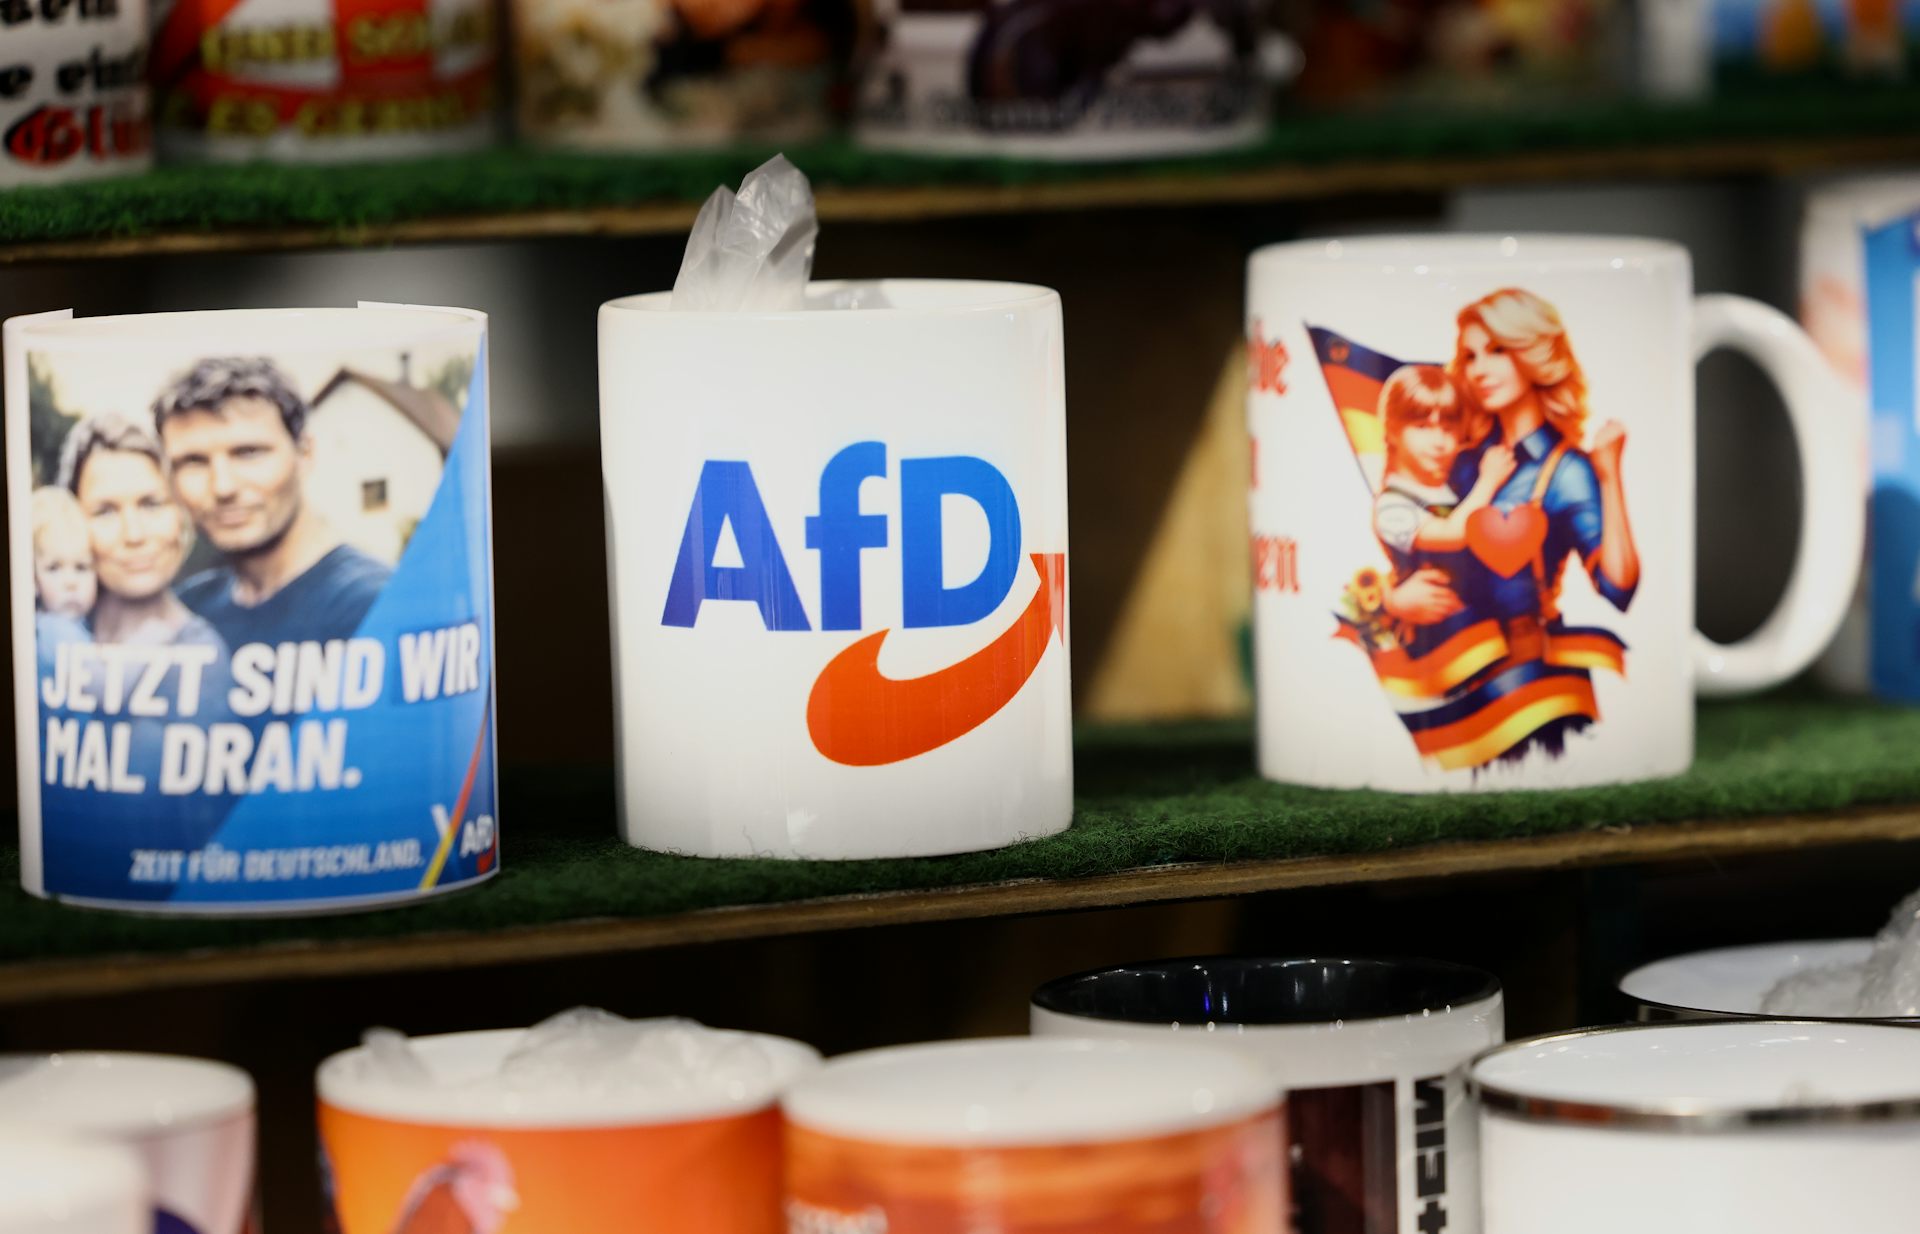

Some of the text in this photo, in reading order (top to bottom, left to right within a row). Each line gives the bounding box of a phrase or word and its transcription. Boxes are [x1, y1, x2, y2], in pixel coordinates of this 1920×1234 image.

[661, 441, 1022, 632] AfD
[42, 623, 482, 718] JETZT SIND WIR
[44, 717, 363, 796] MAL DRAN.
[129, 838, 424, 883] ZEIT FÜR DEUTSCHLAND.
